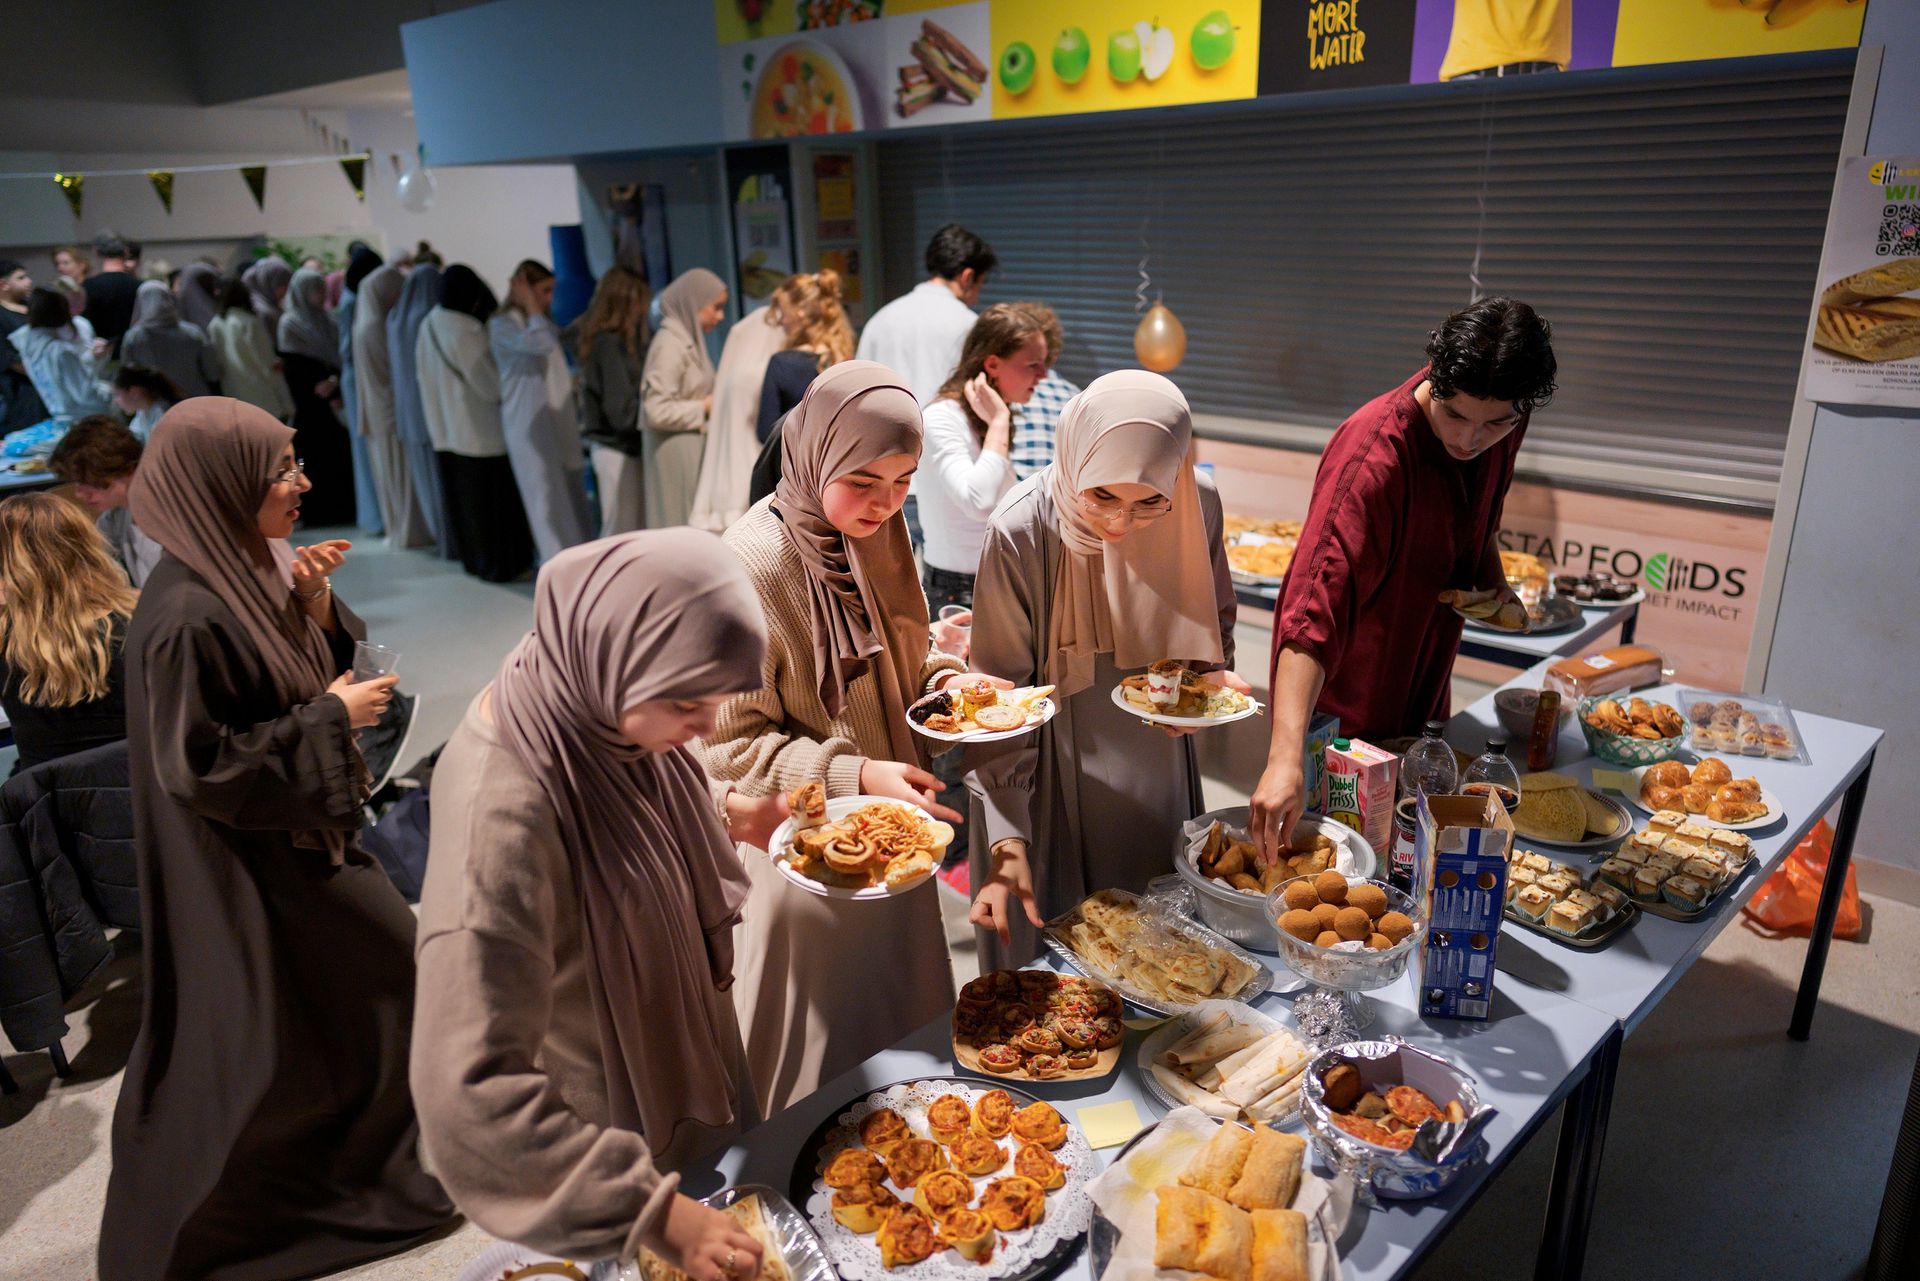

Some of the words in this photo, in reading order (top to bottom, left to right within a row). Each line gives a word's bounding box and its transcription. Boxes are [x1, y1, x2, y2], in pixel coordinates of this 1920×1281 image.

[1307, 0, 1359, 38] MORE
[1310, 29, 1366, 70] WATER
[1885, 186, 1920, 200] WI
[1675, 598, 1742, 621] IMPACT
[1328, 774, 1355, 791] Dubbel
[1399, 852, 1414, 862] RIV
